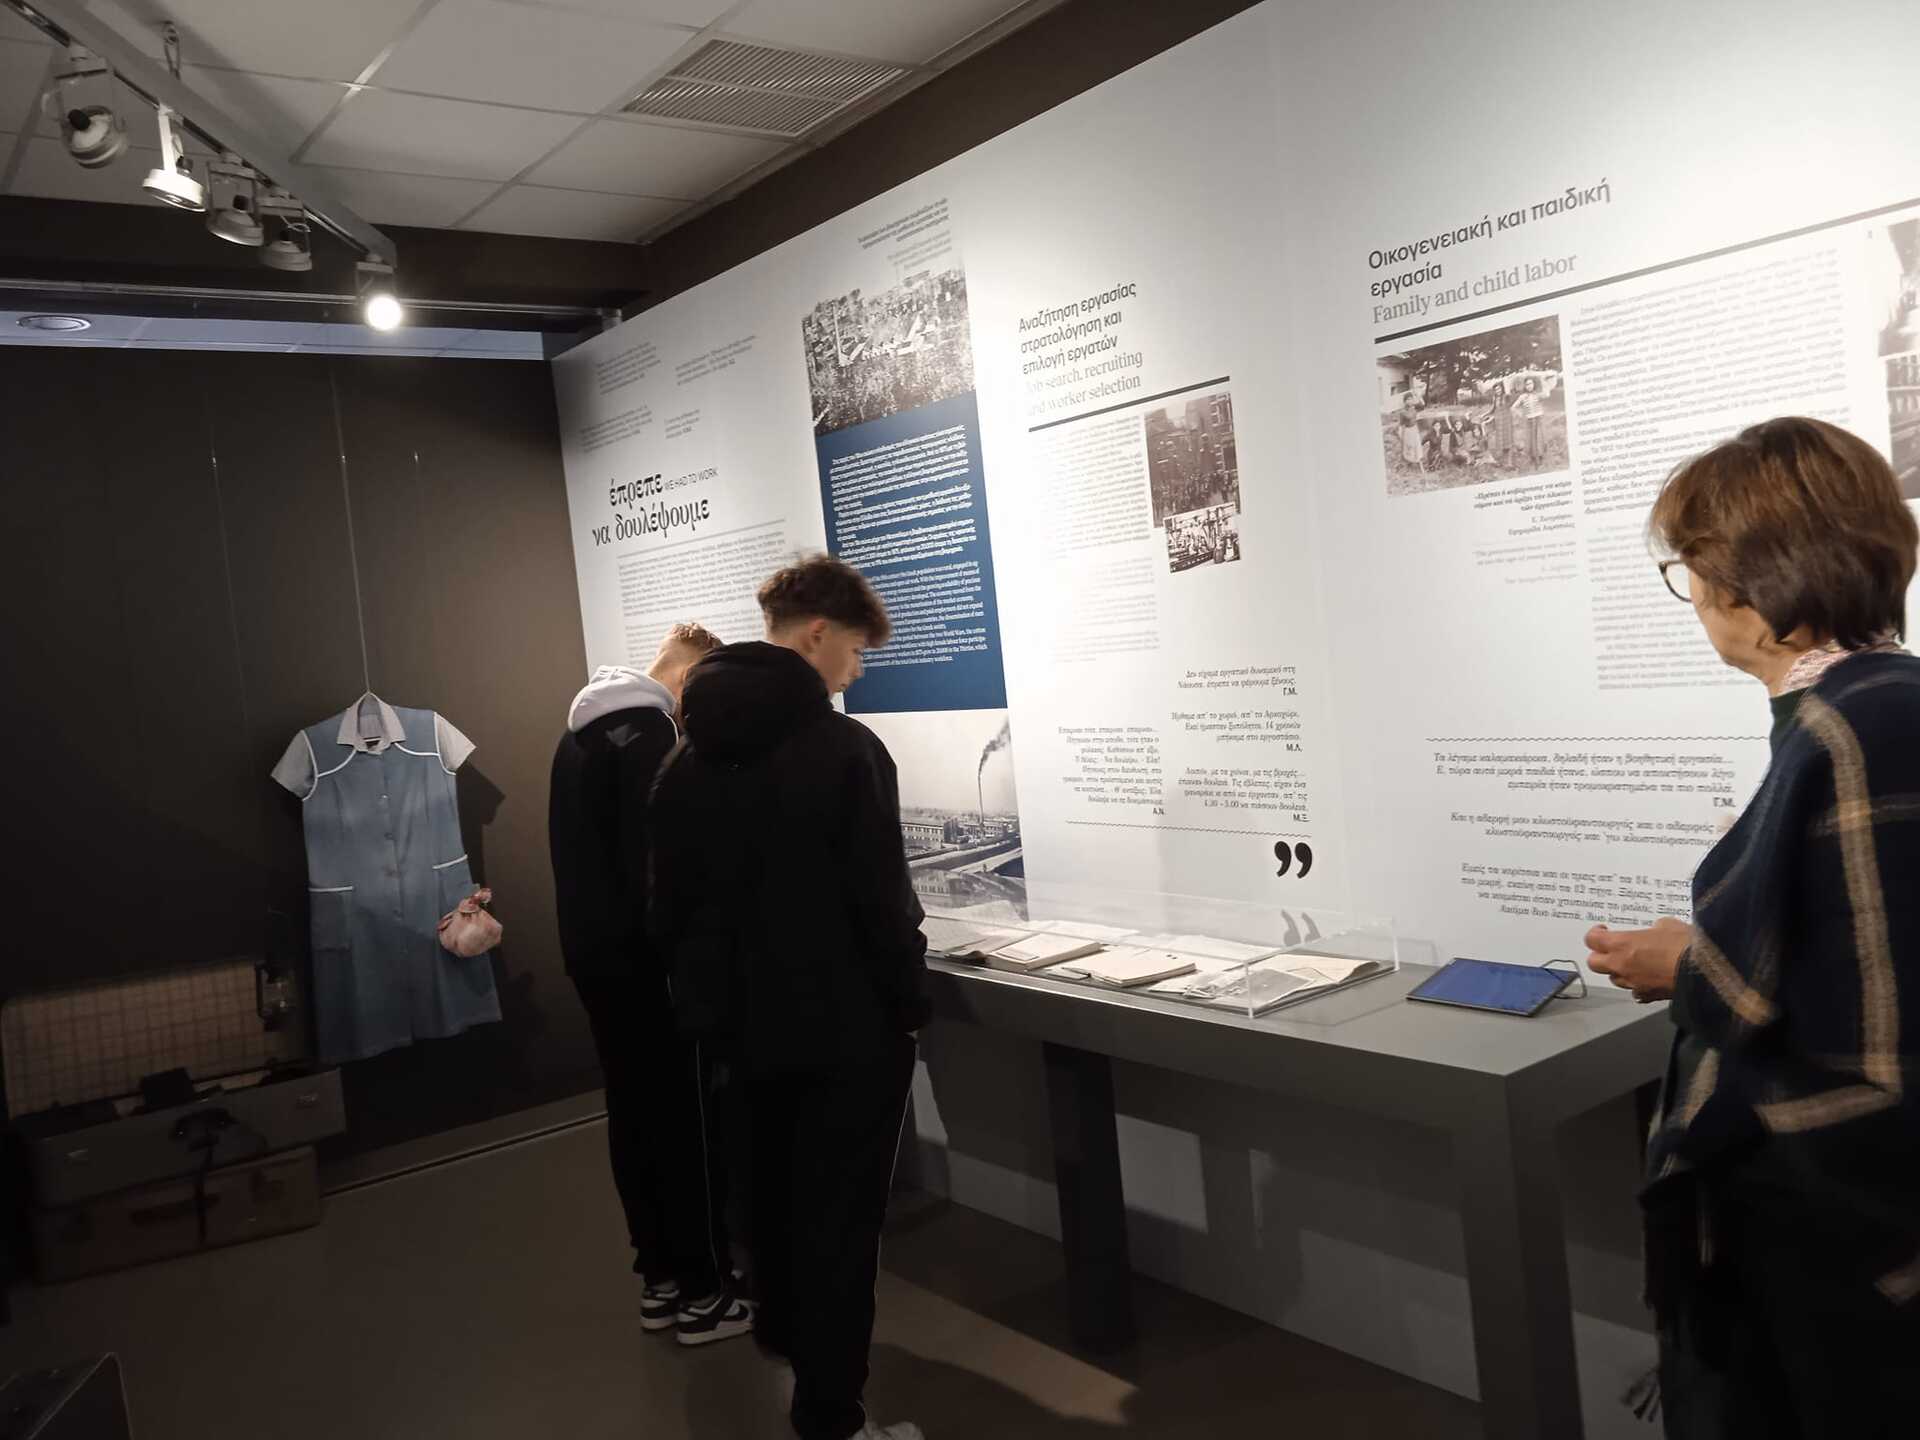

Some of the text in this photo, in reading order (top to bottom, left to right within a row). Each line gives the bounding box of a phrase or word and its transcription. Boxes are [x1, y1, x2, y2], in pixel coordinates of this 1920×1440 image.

[1368, 177, 1610, 269] Οικογενειακή και παιδική
[1370, 262, 1442, 298] εργασία
[1373, 254, 1577, 324] Family and child labor
[1019, 283, 1136, 333] Αναζήτηση εργασίας
[1021, 311, 1122, 353] στρατολόγηση και
[1023, 334, 1118, 375] επιλογή εργατών
[1085, 352, 1143, 378] recruiting
[1089, 375, 1142, 399] selection
[610, 474, 663, 510] έπρεπε
[592, 499, 710, 546] να δουλέψουμε
